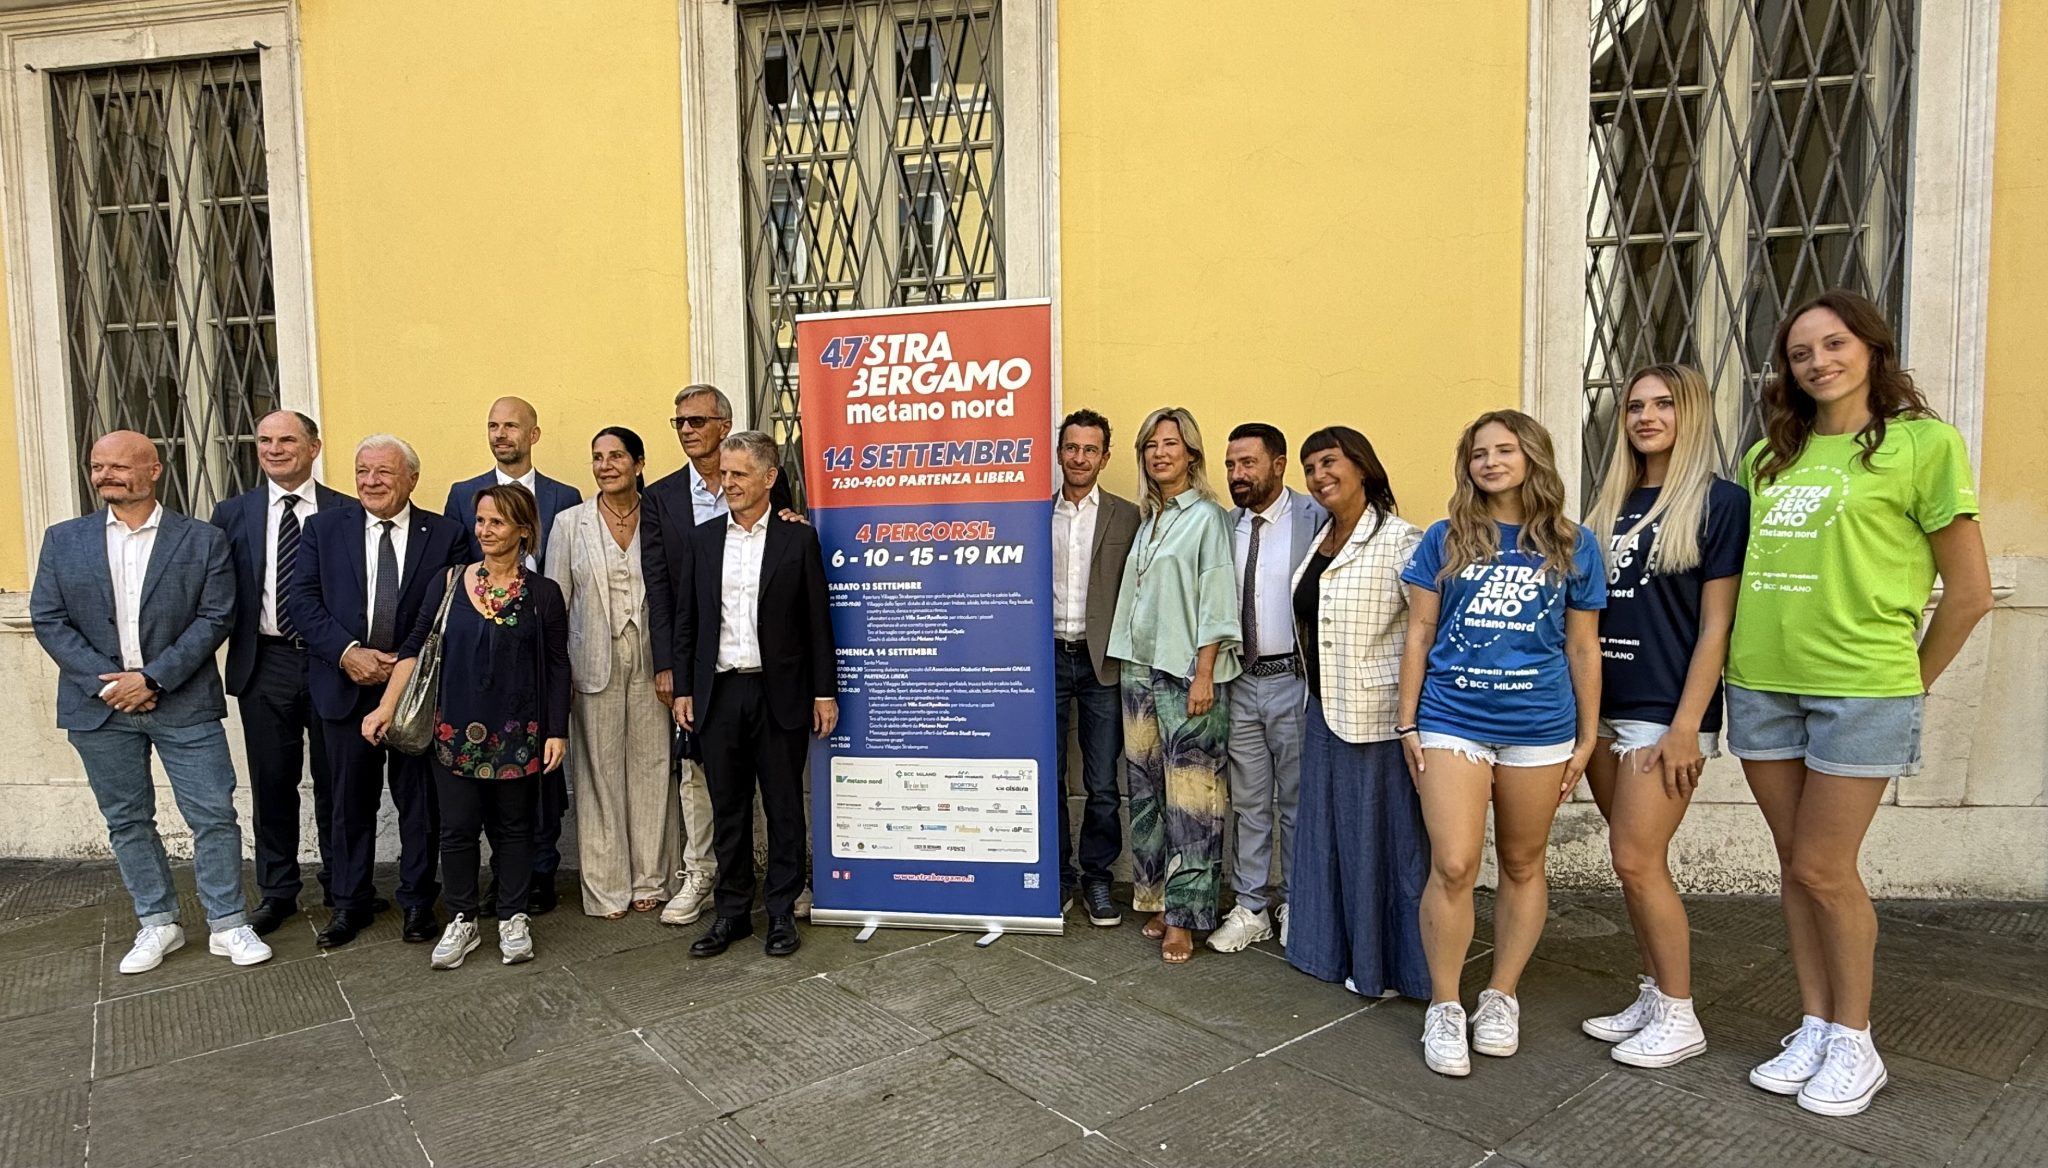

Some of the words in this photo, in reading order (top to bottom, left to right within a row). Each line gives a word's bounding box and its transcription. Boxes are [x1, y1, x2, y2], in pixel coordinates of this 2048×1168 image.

[863, 331, 953, 366] STRA
[847, 358, 1032, 398] BERGAMO
[846, 400, 945, 424] metano
[951, 392, 1014, 419] nord
[823, 447, 854, 472] 14
[860, 438, 1033, 470] SETTEMBRE
[832, 475, 896, 489] 7:30-9:00
[899, 472, 971, 487] PARTENZA
[975, 470, 1025, 484] LIBERA
[1783, 485, 1833, 498] STRA
[1770, 498, 1821, 513] BERG
[1761, 511, 1807, 527] AMO
[856, 524, 871, 543] 4
[875, 521, 996, 542] PERCORSI:
[1760, 529, 1793, 538] metano
[1794, 529, 1818, 538] nord
[831, 550, 845, 568] 6
[863, 549, 890, 567] 10
[910, 547, 934, 566] 15
[953, 546, 980, 565] 19
[985, 545, 1024, 565] KM
[1488, 565, 1546, 586] STRA
[828, 582, 860, 591] SABATO
[861, 582, 871, 591] 13
[872, 582, 922, 590] SETTEMBRE
[1475, 581, 1538, 602] BERG
[1763, 582, 1777, 590] BCC
[1779, 584, 1812, 592] MILANO
[1465, 597, 1522, 617] AMO
[1464, 617, 1506, 629] metano
[1507, 622, 1536, 633] nord
[835, 648, 874, 656] OMENICA
[876, 648, 886, 656] 14
[888, 648, 938, 656] SETTEMBRE
[1600, 650, 1634, 661] MILANO
[1470, 680, 1489, 689] BCC
[1494, 681, 1534, 690] MILANO
